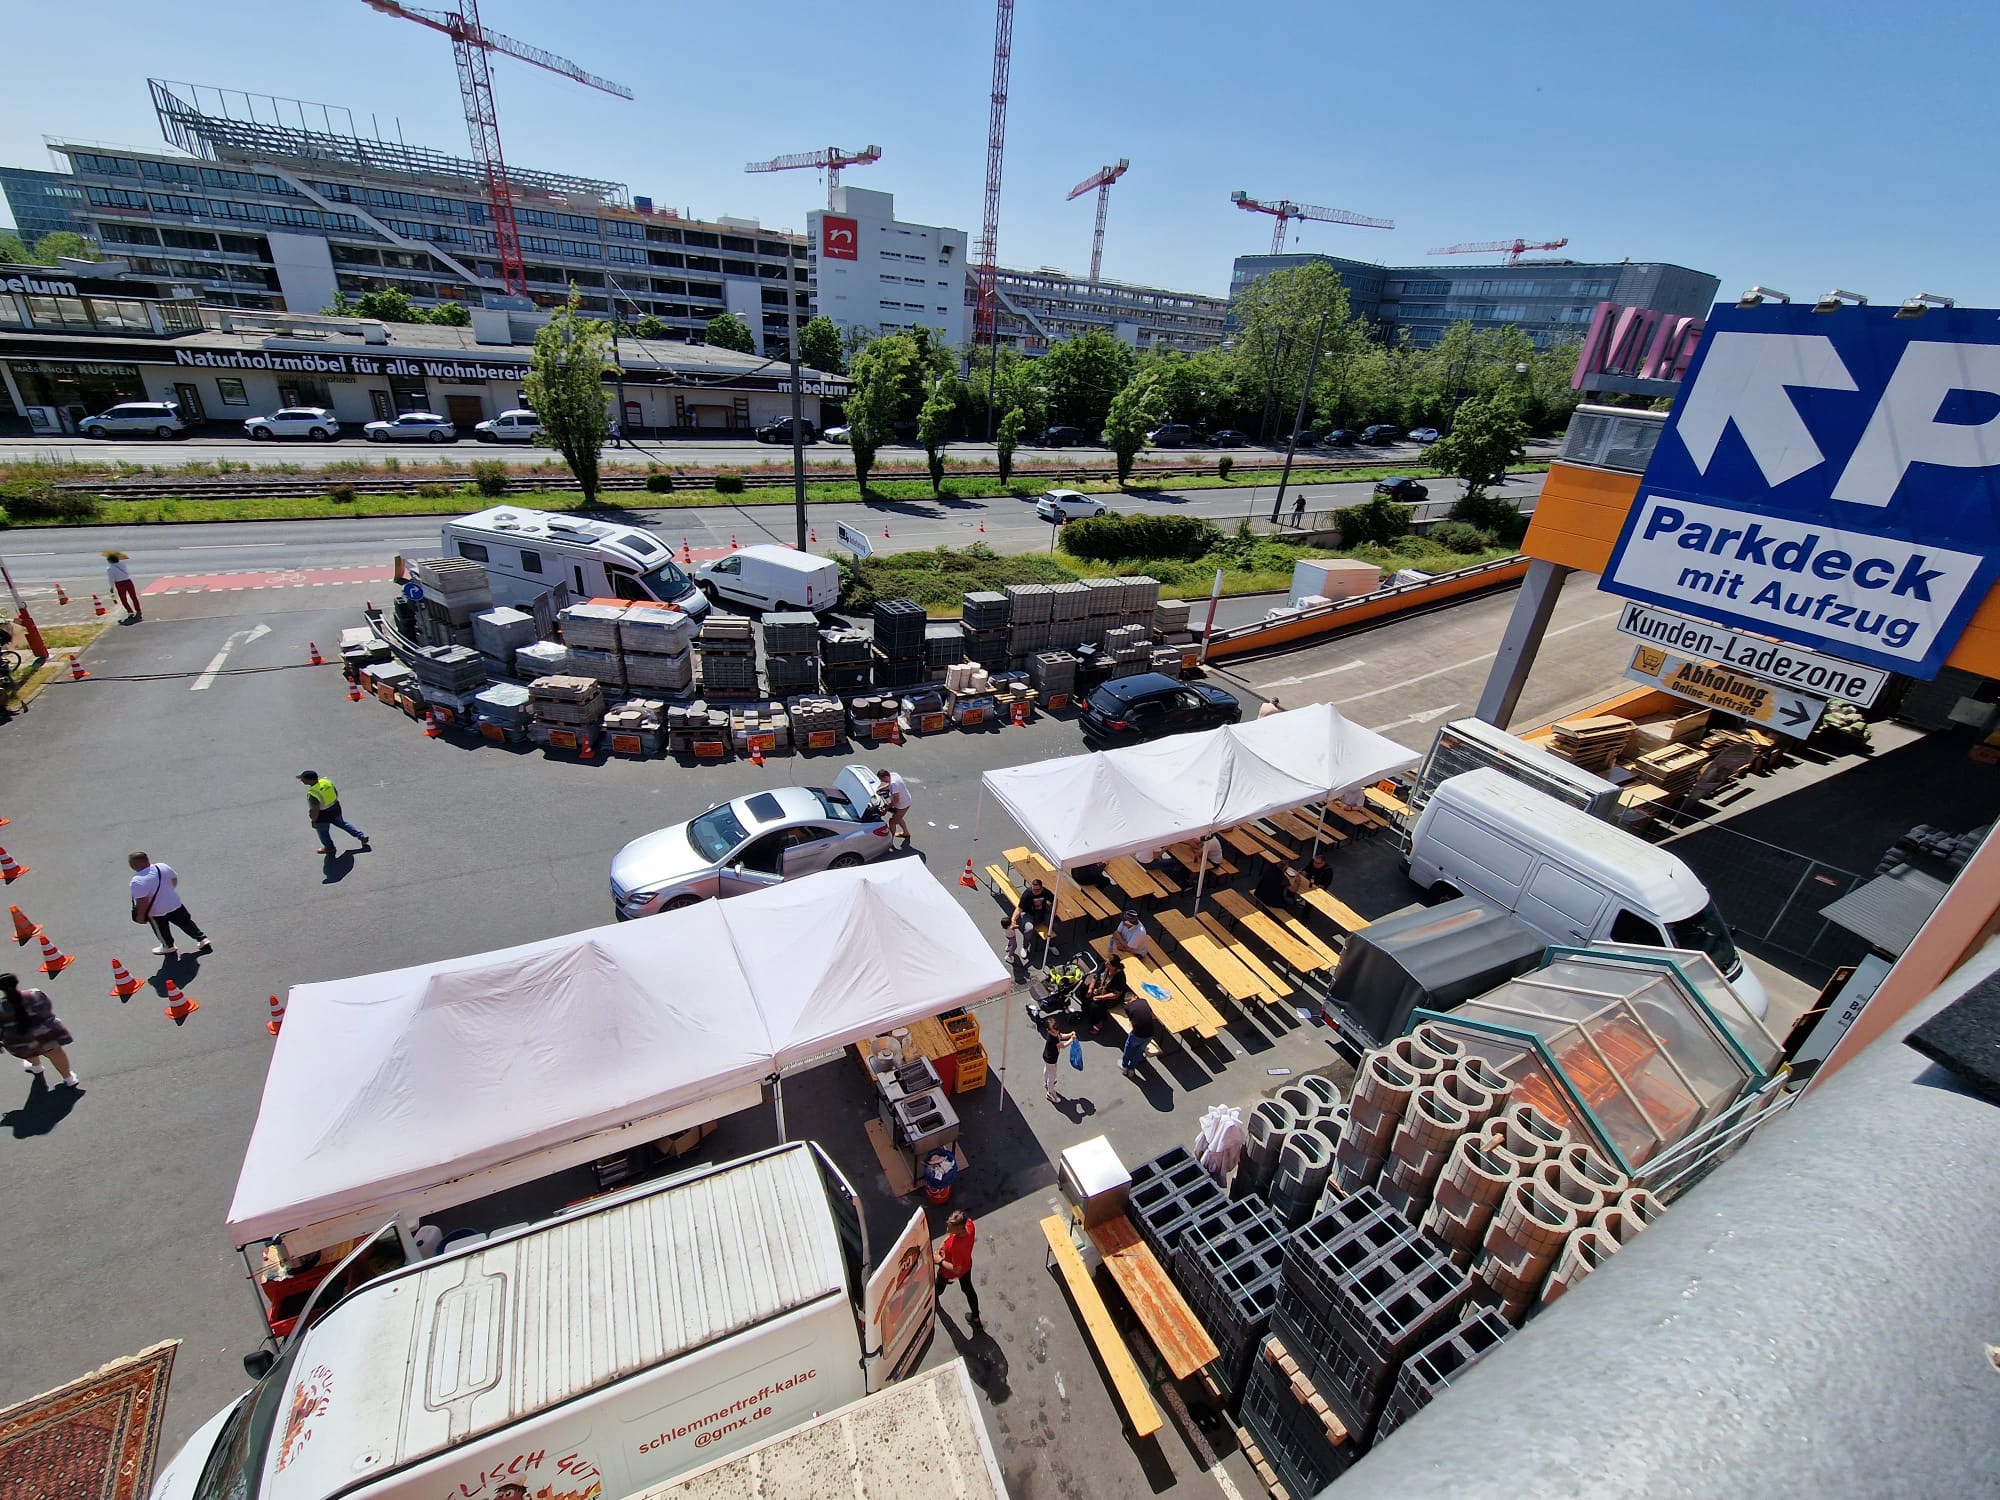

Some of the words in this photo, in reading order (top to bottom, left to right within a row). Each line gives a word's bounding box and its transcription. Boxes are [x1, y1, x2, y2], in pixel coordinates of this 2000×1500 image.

[175, 349, 347, 374] Naturholzmöbel
[351, 356, 379, 376] für
[386, 358, 420, 376] alle
[777, 380, 848, 396] mbelum
[1830, 339, 2000, 508] P
[1643, 504, 1947, 602] Parkdeck
[1677, 565, 1746, 600] mit
[1751, 580, 1921, 649] Aufzug
[1624, 607, 1868, 699] Kunden-Ladezone
[1671, 680, 1757, 716] Online-Aufträge
[1677, 661, 1769, 709] Abholung
[639, 1369, 818, 1454] schlemmertreff-kalac
[694, 1405, 773, 1449] @gmx.de
[556, 1452, 601, 1483] GUT
